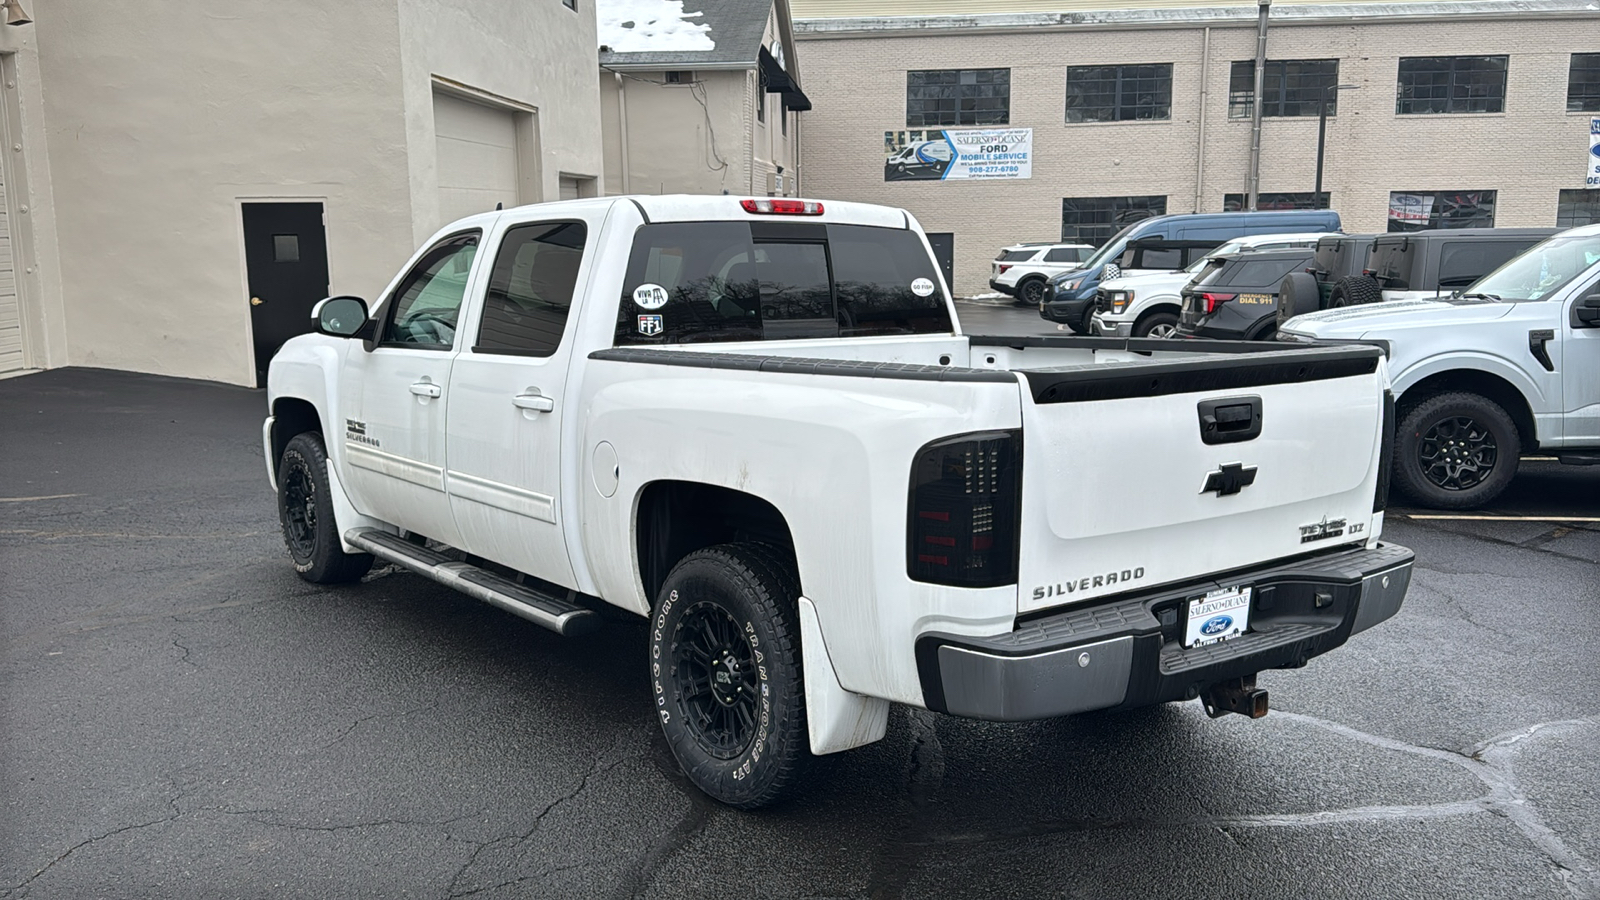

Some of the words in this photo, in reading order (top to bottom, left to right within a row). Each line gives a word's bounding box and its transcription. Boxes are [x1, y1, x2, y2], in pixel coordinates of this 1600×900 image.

[957, 136, 994, 144] SALERNO
[998, 134, 1026, 143] DUANE
[980, 145, 1008, 153] FORD
[637, 290, 651, 298] VIVA
[640, 320, 661, 333] FF1
[1032, 566, 1145, 600] SILVERADO
[1190, 602, 1221, 617] SALERNO
[1224, 595, 1248, 608] DUANE
[1206, 619, 1227, 634] Ford
[745, 622, 770, 762] TRANSFORCE
